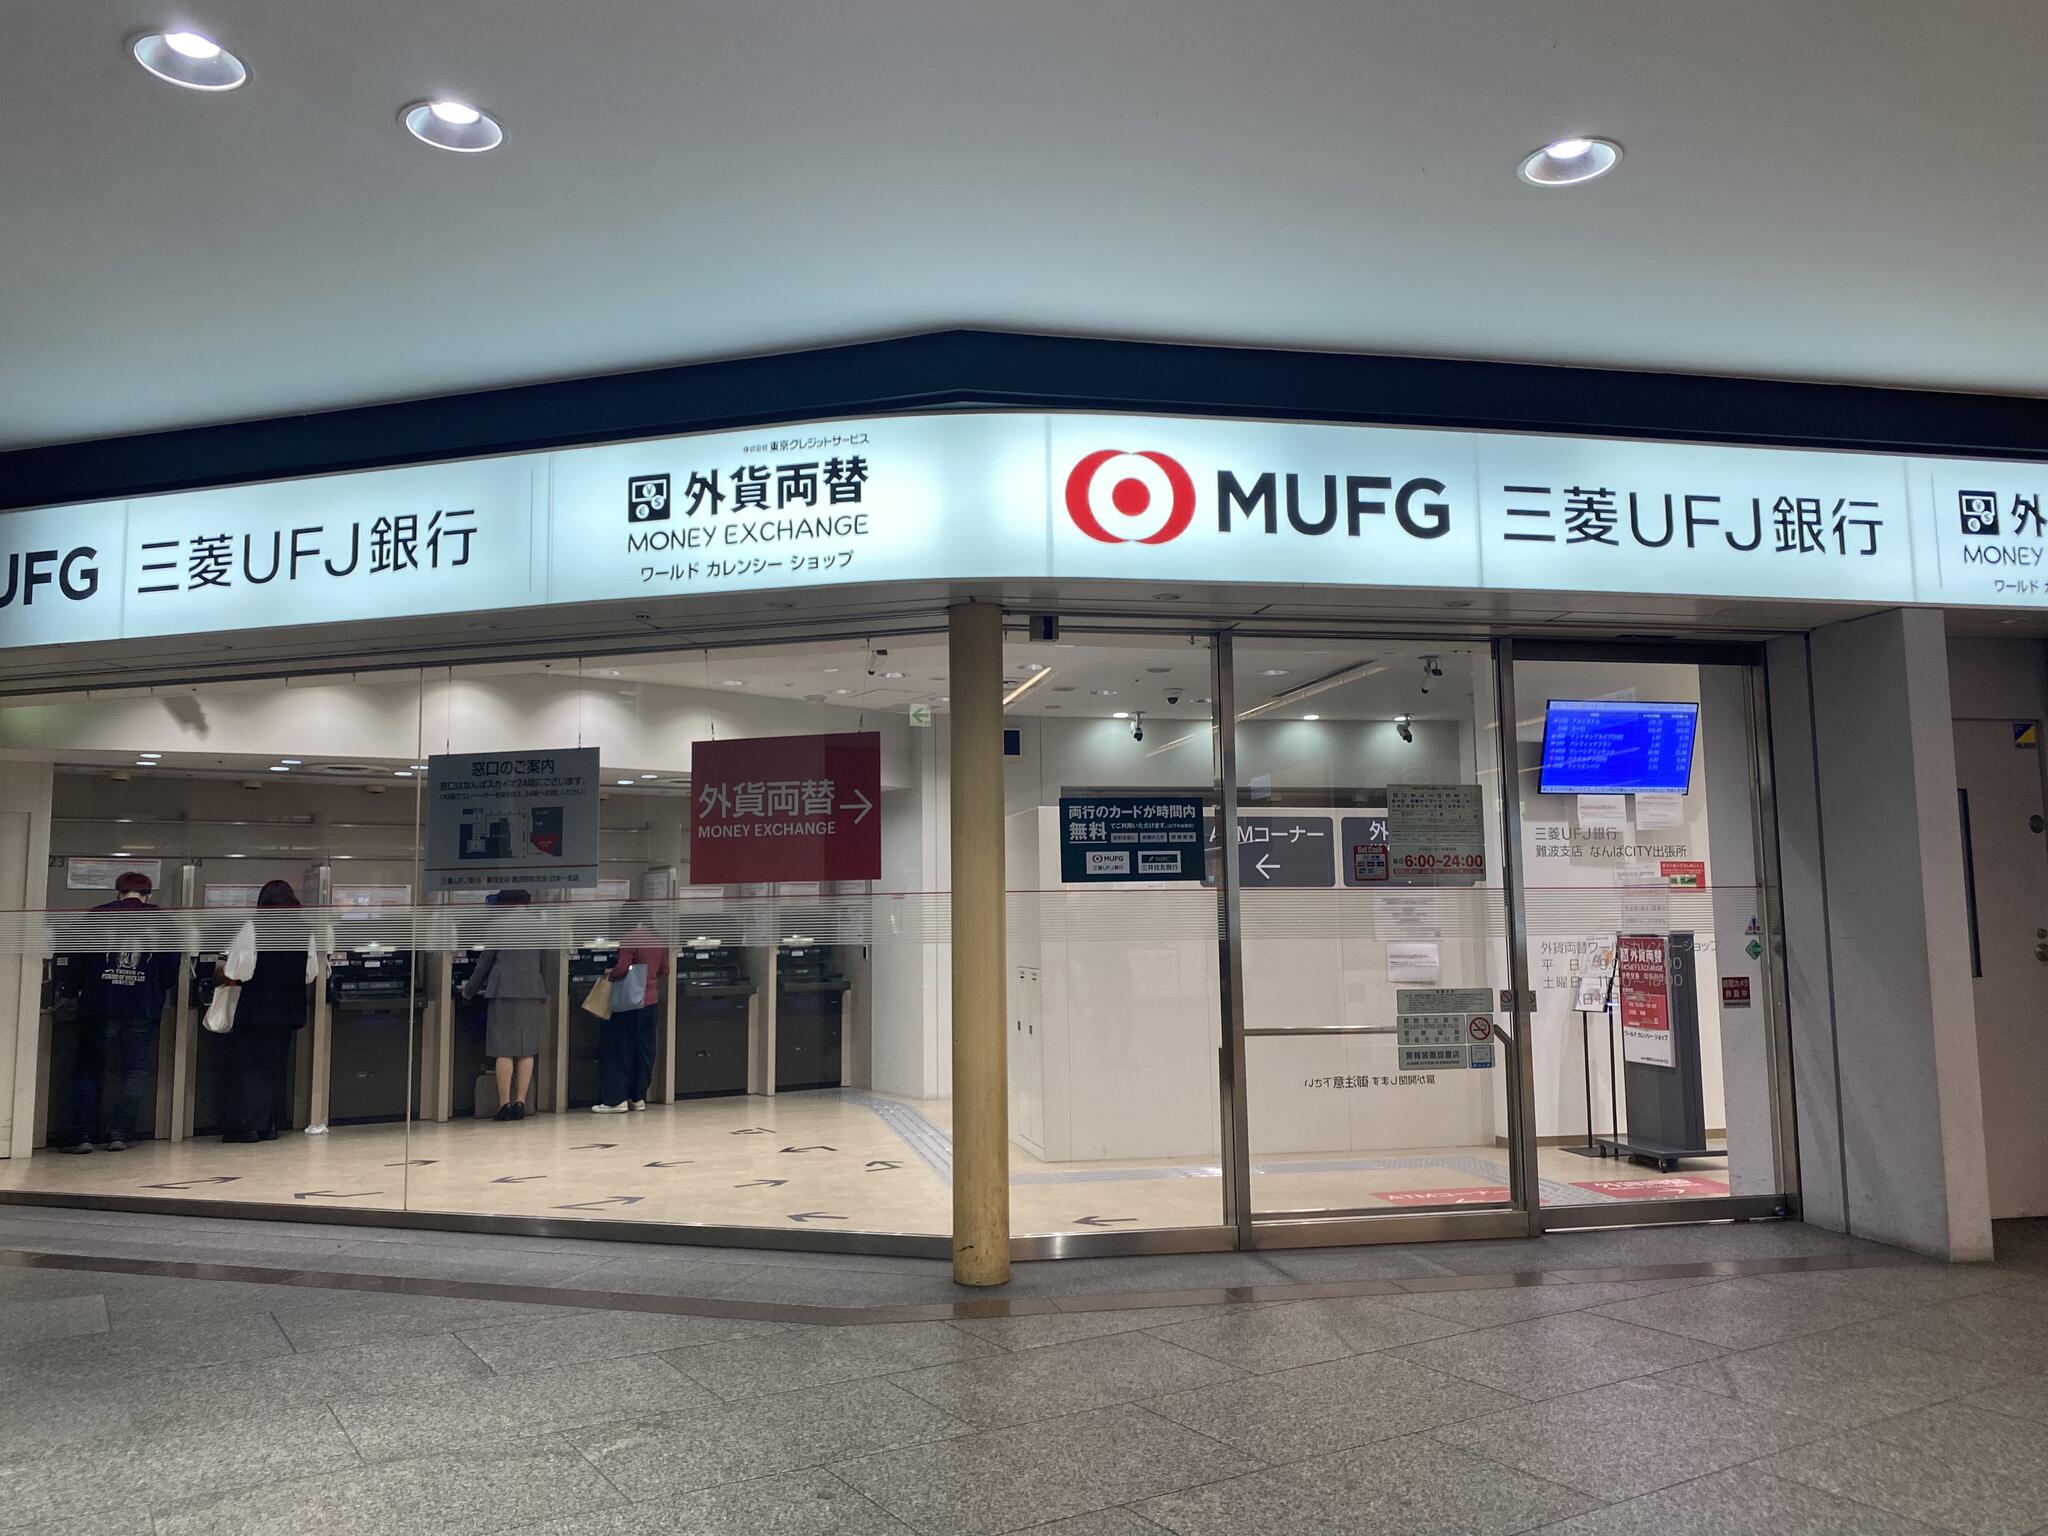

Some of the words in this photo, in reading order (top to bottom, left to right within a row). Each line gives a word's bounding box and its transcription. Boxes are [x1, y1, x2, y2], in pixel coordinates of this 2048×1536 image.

[684, 454, 869, 517] 外貨両替
[1217, 470, 1451, 540] MUFG
[1503, 485, 1884, 557] 三菱UFJ銀行
[628, 525, 717, 553] MONEY
[724, 514, 869, 546] EXCHANGE
[138, 508, 478, 593] 三菱UFJ銀行
[1963, 544, 2043, 566] MONEY
[641, 562, 700, 583] ワールド
[707, 557, 783, 579] カレンシー
[790, 549, 855, 572] ショップ
[1994, 580, 2039, 593] ワールド
[471, 758, 555, 777] 窓口のご案内
[698, 778, 836, 820] 外貨両替
[1068, 804, 1196, 820] 両行のカードが時間内
[698, 824, 750, 839] MONEY
[754, 821, 836, 837] EXCHANGE
[1068, 821, 1107, 841] 無料
[1535, 827, 1618, 841] 三菱UFJ銀行
[1536, 845, 1583, 858] 難波支店
[1590, 844, 1687, 858] なんばCITY出張所
